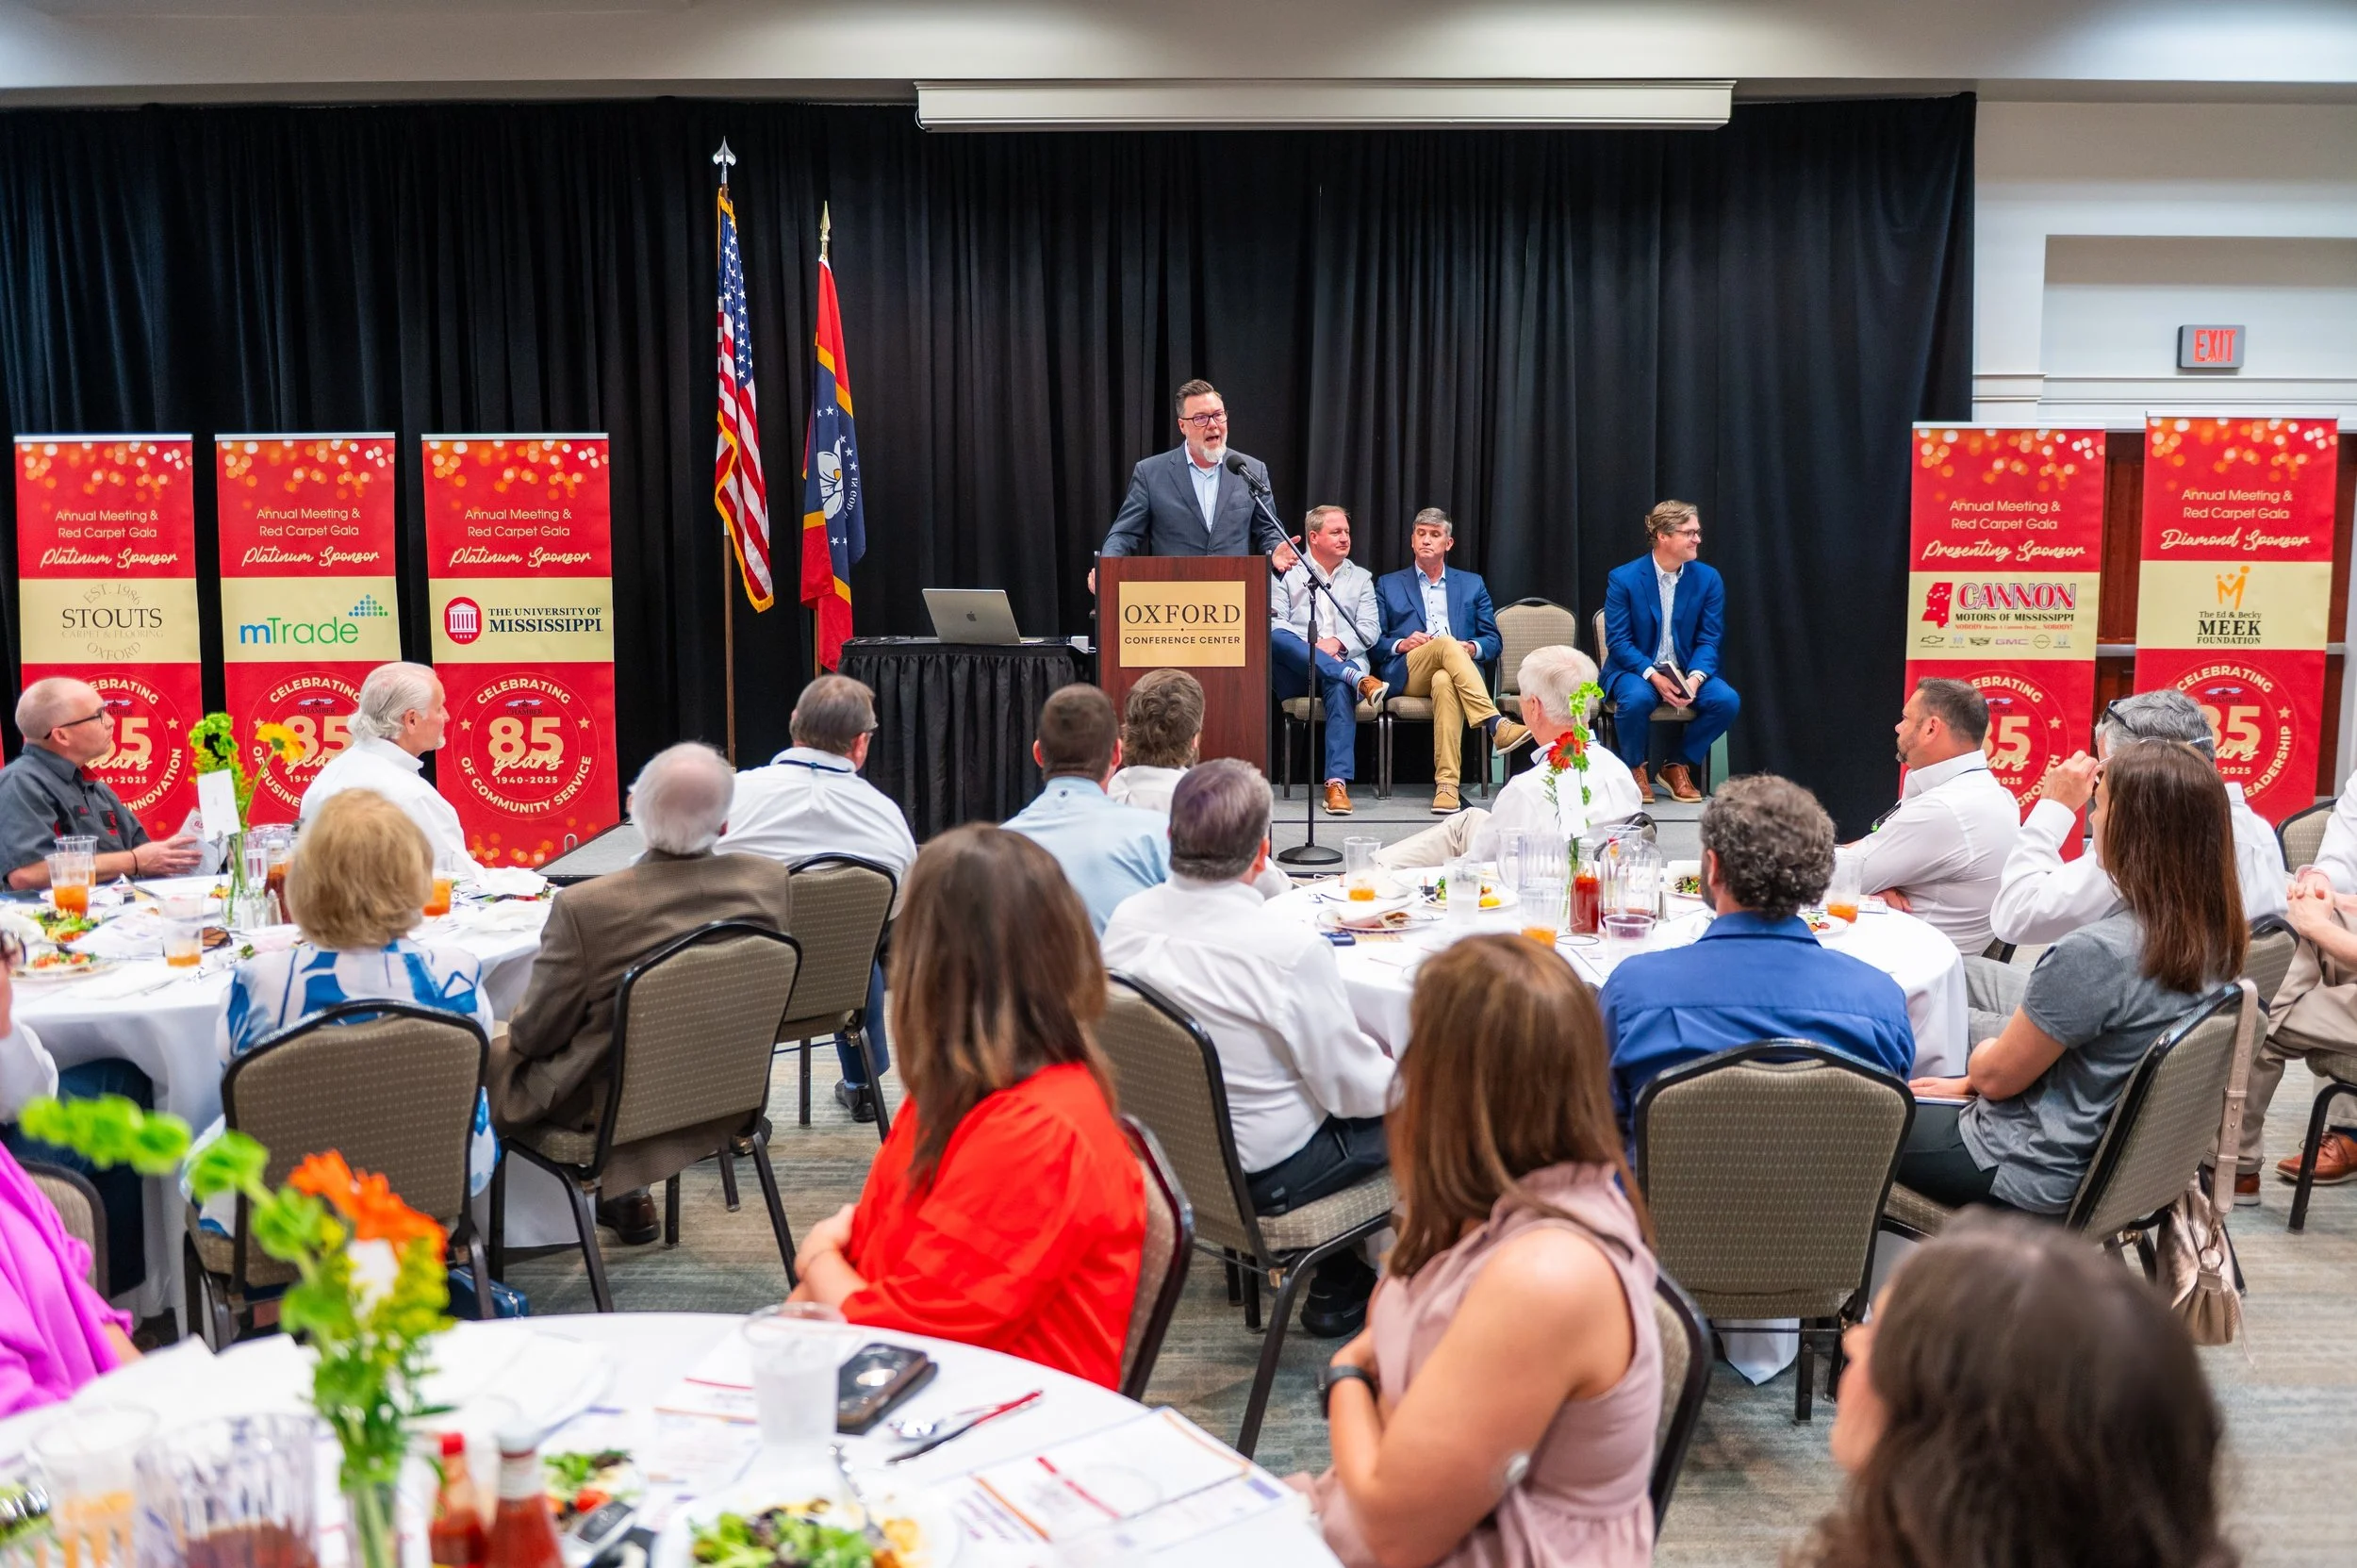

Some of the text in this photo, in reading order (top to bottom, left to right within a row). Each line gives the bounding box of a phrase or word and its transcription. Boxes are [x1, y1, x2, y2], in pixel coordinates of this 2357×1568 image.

[2194, 328, 2237, 363] EXIT
[2182, 489, 2293, 503] Annual Meeting &
[55, 510, 158, 523] Annual Meeting &
[256, 508, 361, 520] Annual Meeting &
[465, 509, 572, 521] Annual Meeting &
[1950, 501, 2061, 514] Annual Meeting &
[2184, 507, 2290, 520] Red Carpet Gala
[58, 527, 157, 539] Red Carpet Gala
[259, 525, 359, 537] Red Carpet Gala
[468, 526, 570, 538] Red Carpet Gala
[1951, 519, 2058, 532] Red Carpet Gala
[2160, 527, 2311, 552] Diamond Sponsor
[40, 547, 178, 569] Platinum Sponsor
[241, 545, 380, 568] Platinum Sponsor
[449, 546, 592, 569] Platinum Sponsor
[1921, 538, 2085, 562] Presenting Sponsor
[1957, 583, 2076, 610] CANNON
[62, 608, 163, 629] STOUTS
[488, 608, 512, 617] THE
[587, 607, 602, 616] OF
[1124, 604, 1241, 624] OXFORD
[1955, 613, 2074, 621] MOTORS OF MISSISSIPPI
[2238, 611, 2262, 619] Becky
[239, 617, 358, 644] mTrade
[488, 619, 602, 633] MISSISSIPPI
[2197, 619, 2261, 635] MEEK
[1125, 636, 1195, 645] CONFERENCE
[2197, 636, 2261, 645] FOUNDATION
[87, 641, 141, 661] OXFORD
[2176, 665, 2274, 693] CELEBRATING
[90, 678, 159, 705] EBRATING
[477, 678, 571, 704] CELEBRATING
[1971, 676, 2043, 703] EBRATING
[488, 717, 565, 760] 85
[491, 753, 565, 777] years
[2217, 767, 2251, 775] -2025
[2244, 726, 2292, 798] EADERSHIP
[99, 776, 148, 784] 40-2025
[261, 767, 302, 807] BUSINE
[461, 756, 592, 814] OF COMMUNITY SERVICE
[496, 776, 558, 784] 1940-2025
